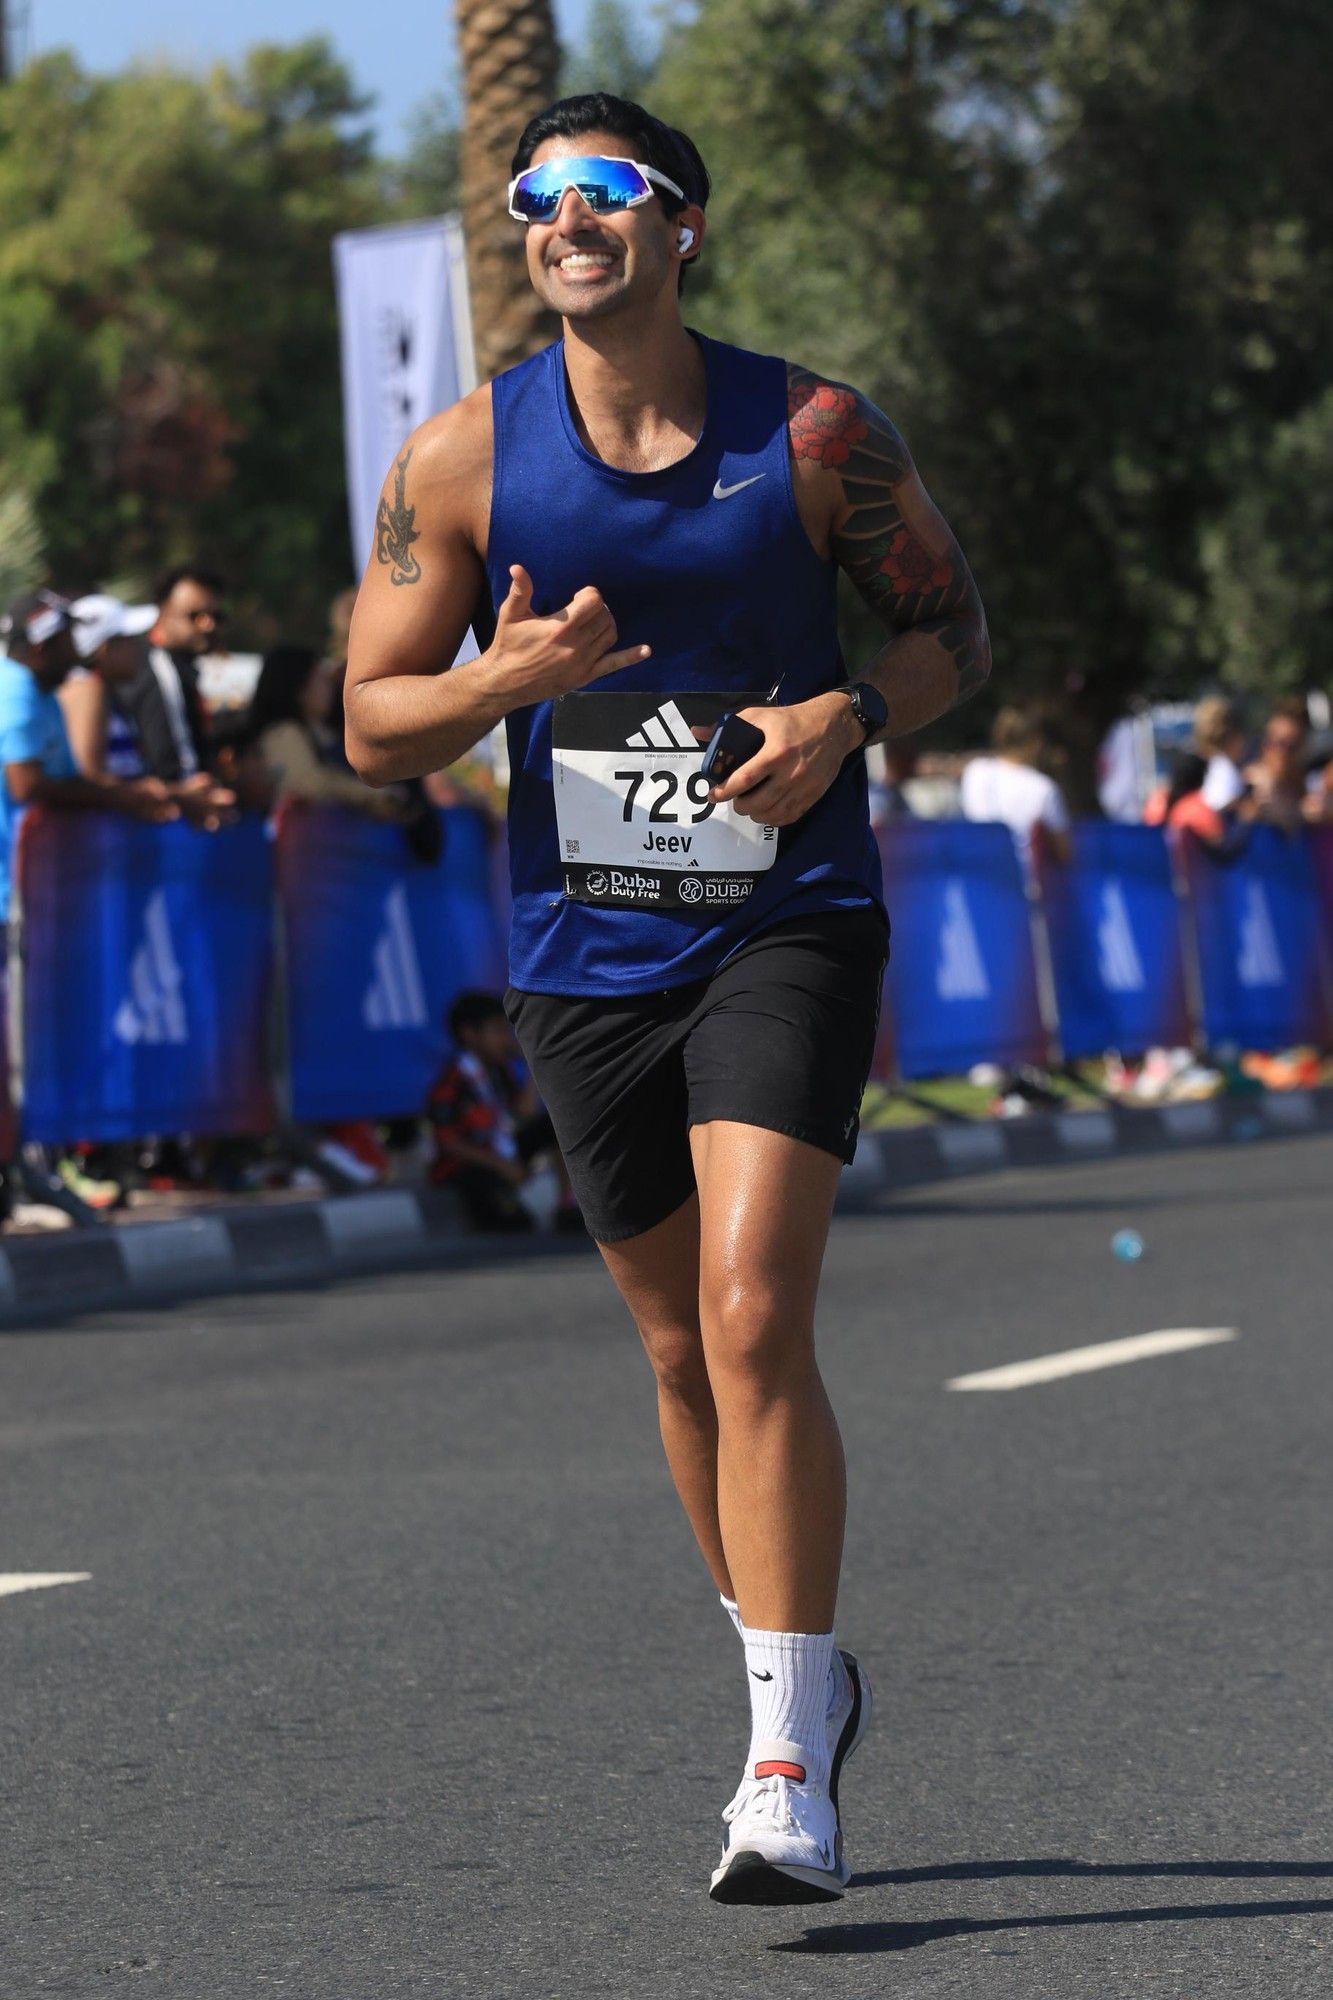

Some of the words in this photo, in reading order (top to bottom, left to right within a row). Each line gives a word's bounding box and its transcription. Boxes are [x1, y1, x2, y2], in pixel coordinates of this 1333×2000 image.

[614, 770, 717, 824] 729
[642, 831, 693, 853] Jeev
[609, 870, 661, 890] Dubai
[610, 885, 636, 899] Duty
[637, 888, 660, 899] Free
[705, 884, 753, 897] DUBAI
